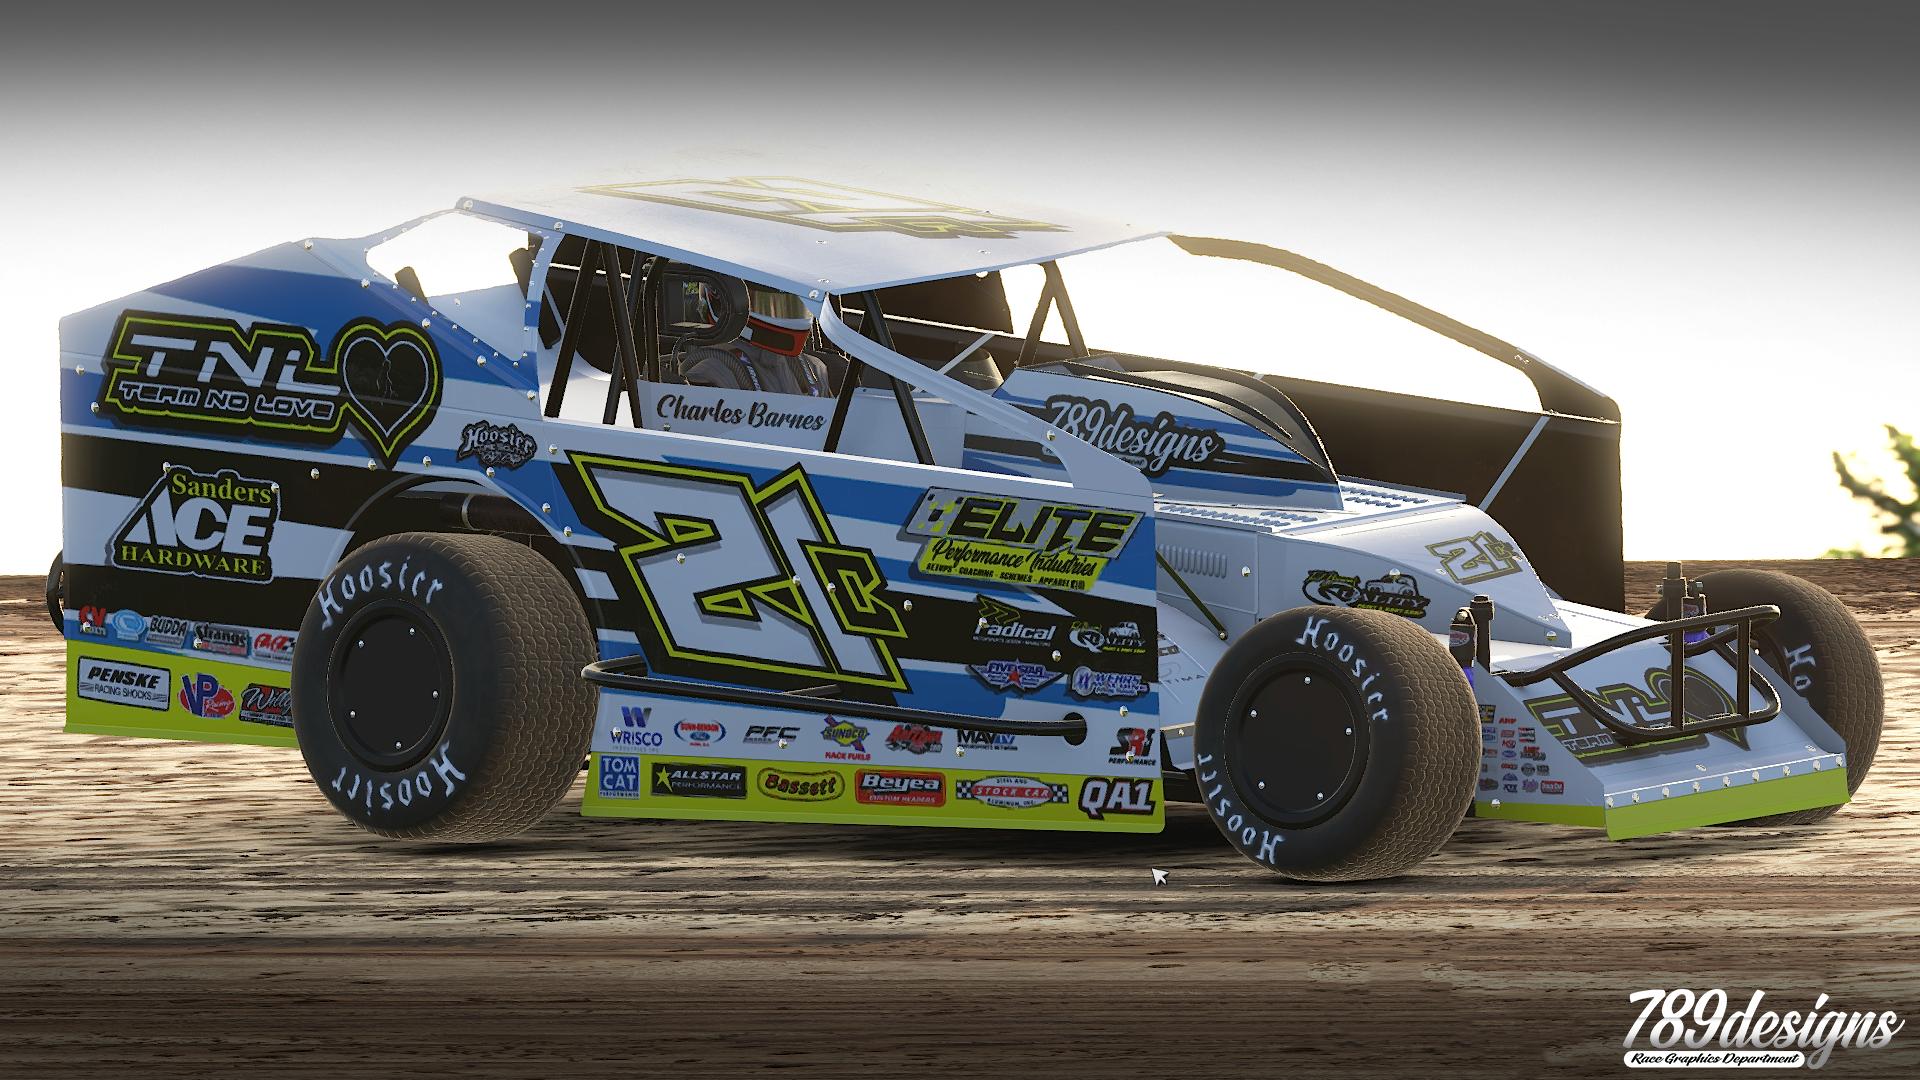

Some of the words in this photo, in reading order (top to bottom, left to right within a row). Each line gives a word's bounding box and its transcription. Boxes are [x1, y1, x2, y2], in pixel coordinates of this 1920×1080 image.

[130, 334, 341, 397] TNL
[118, 382, 199, 407] TEAM
[204, 390, 248, 411] NO
[254, 396, 335, 420] LOVE
[657, 394, 746, 424] Charles
[749, 402, 827, 431] Barnes
[463, 427, 533, 454] Hoosier
[172, 474, 273, 505] Sanders
[124, 486, 272, 556] ACE
[948, 497, 1133, 553] ELITE
[121, 546, 266, 577] HARDWARE
[932, 538, 1023, 568] Performance
[1025, 549, 1098, 577] Industries
[1000, 572, 1032, 582] SCHEMES
[318, 555, 443, 630] Hoosier
[150, 616, 188, 636] BUDDA
[88, 666, 161, 689] PENSKE
[988, 661, 1016, 672] FIVE
[1296, 616, 1389, 721] Hoosier
[93, 683, 121, 695] RACING
[122, 687, 151, 700] SHOCKS
[182, 673, 219, 717] VP
[610, 730, 663, 746] WRISCO
[744, 725, 800, 740] PFC
[824, 728, 868, 740] SUNOCO
[602, 758, 636, 773] TOM
[848, 753, 871, 761] FUELS
[1108, 757, 1156, 766] PERFMANCE
[332, 740, 466, 817] Hoosier
[603, 774, 636, 790] CAT
[670, 769, 742, 782] ALLSTAR
[672, 782, 742, 791] PERFORMANCE
[765, 774, 837, 796] Bassett
[861, 774, 940, 792] Beyea
[869, 794, 900, 802] CUSTOM
[901, 796, 936, 804] HEADERS
[976, 787, 1017, 796] STOCK
[1025, 788, 1049, 798] CAR
[1080, 779, 1154, 819] QA1
[1198, 754, 1287, 865] Hoosier
